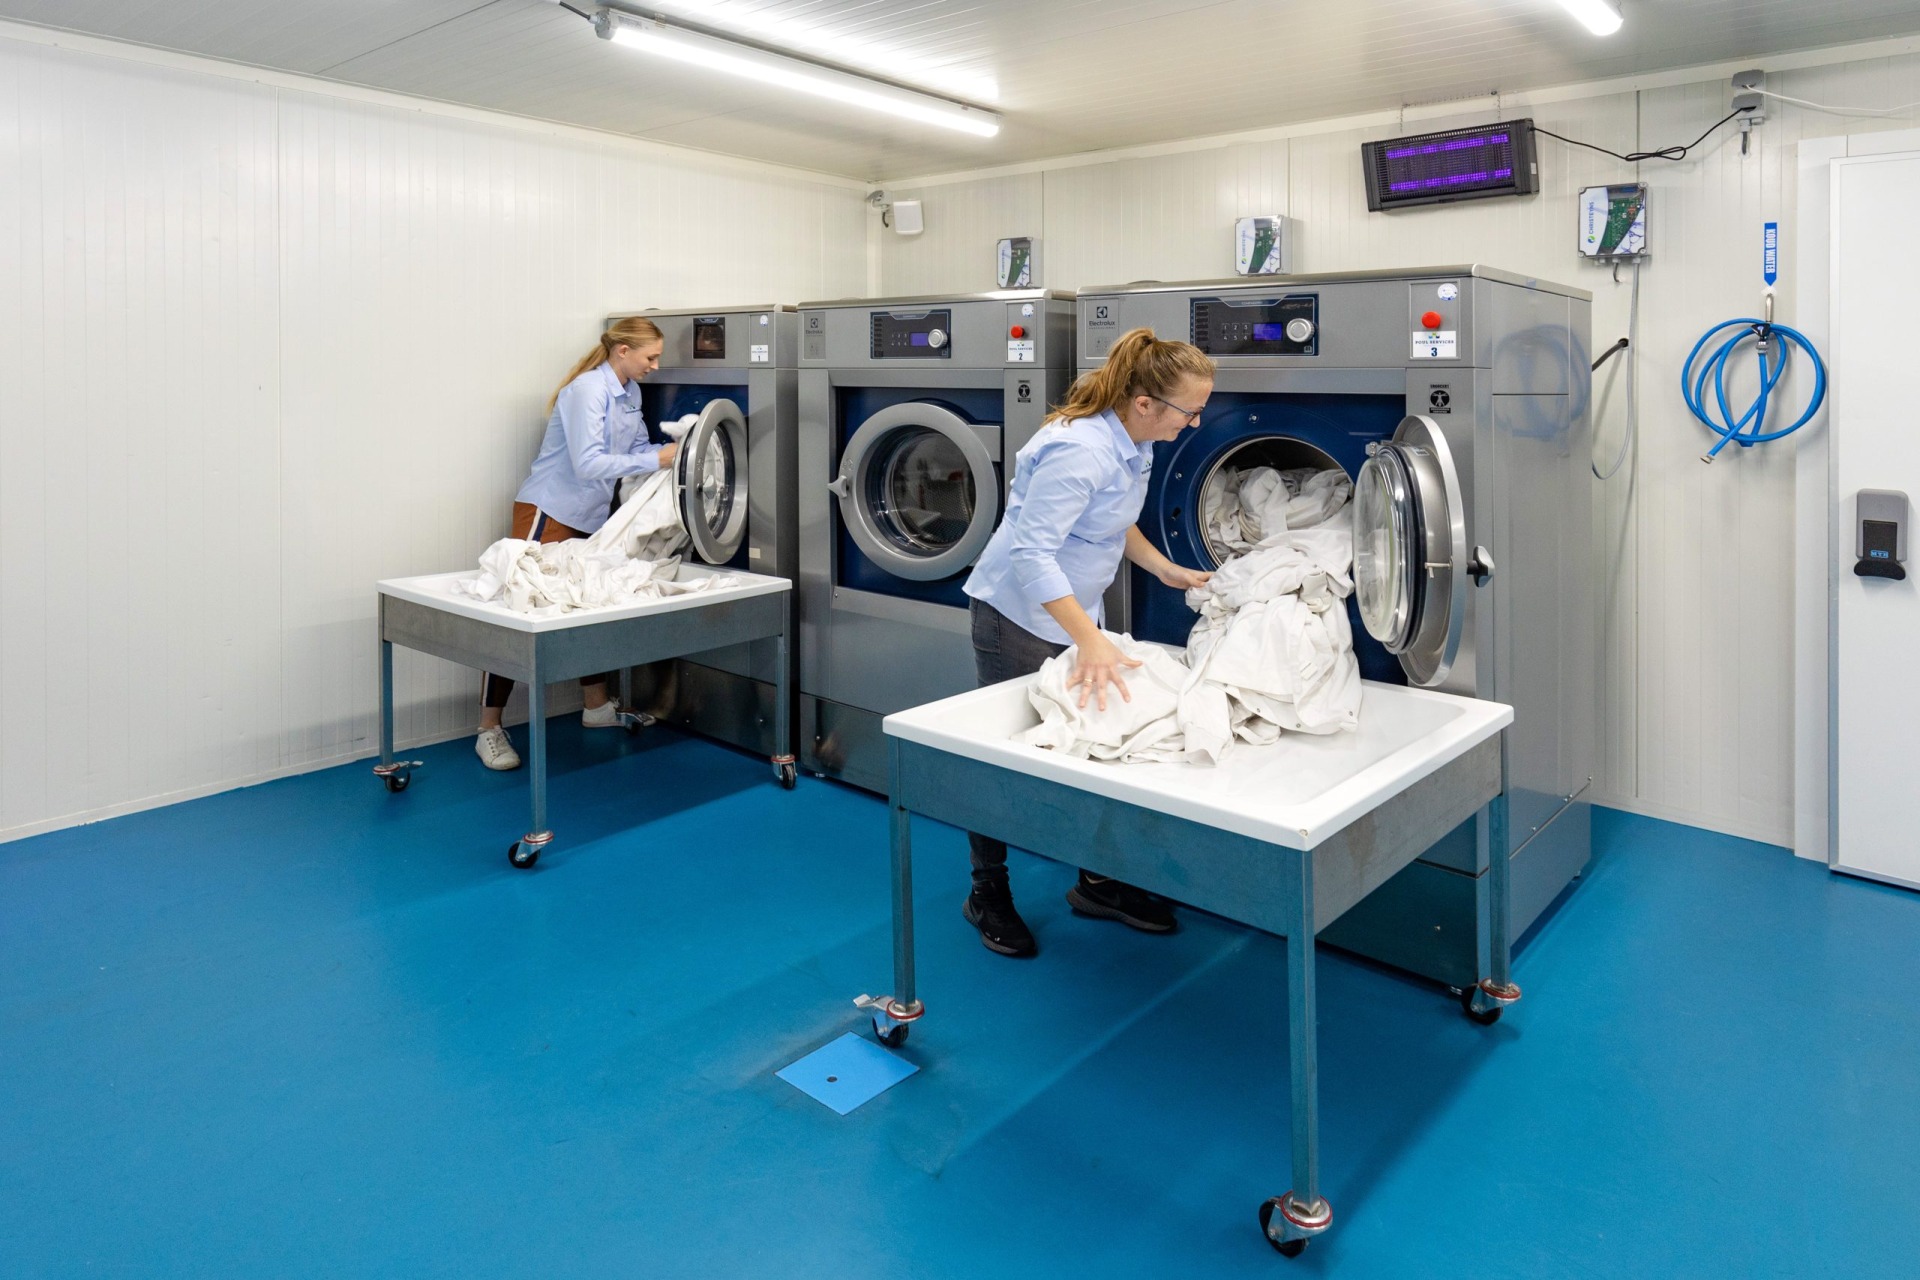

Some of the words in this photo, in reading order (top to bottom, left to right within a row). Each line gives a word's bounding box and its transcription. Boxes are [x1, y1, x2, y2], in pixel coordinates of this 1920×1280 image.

[1766, 229, 1776, 248] KOUD
[1766, 249, 1776, 273] WATER
[1018, 352, 1023, 360] 2
[1431, 347, 1437, 357] 3
